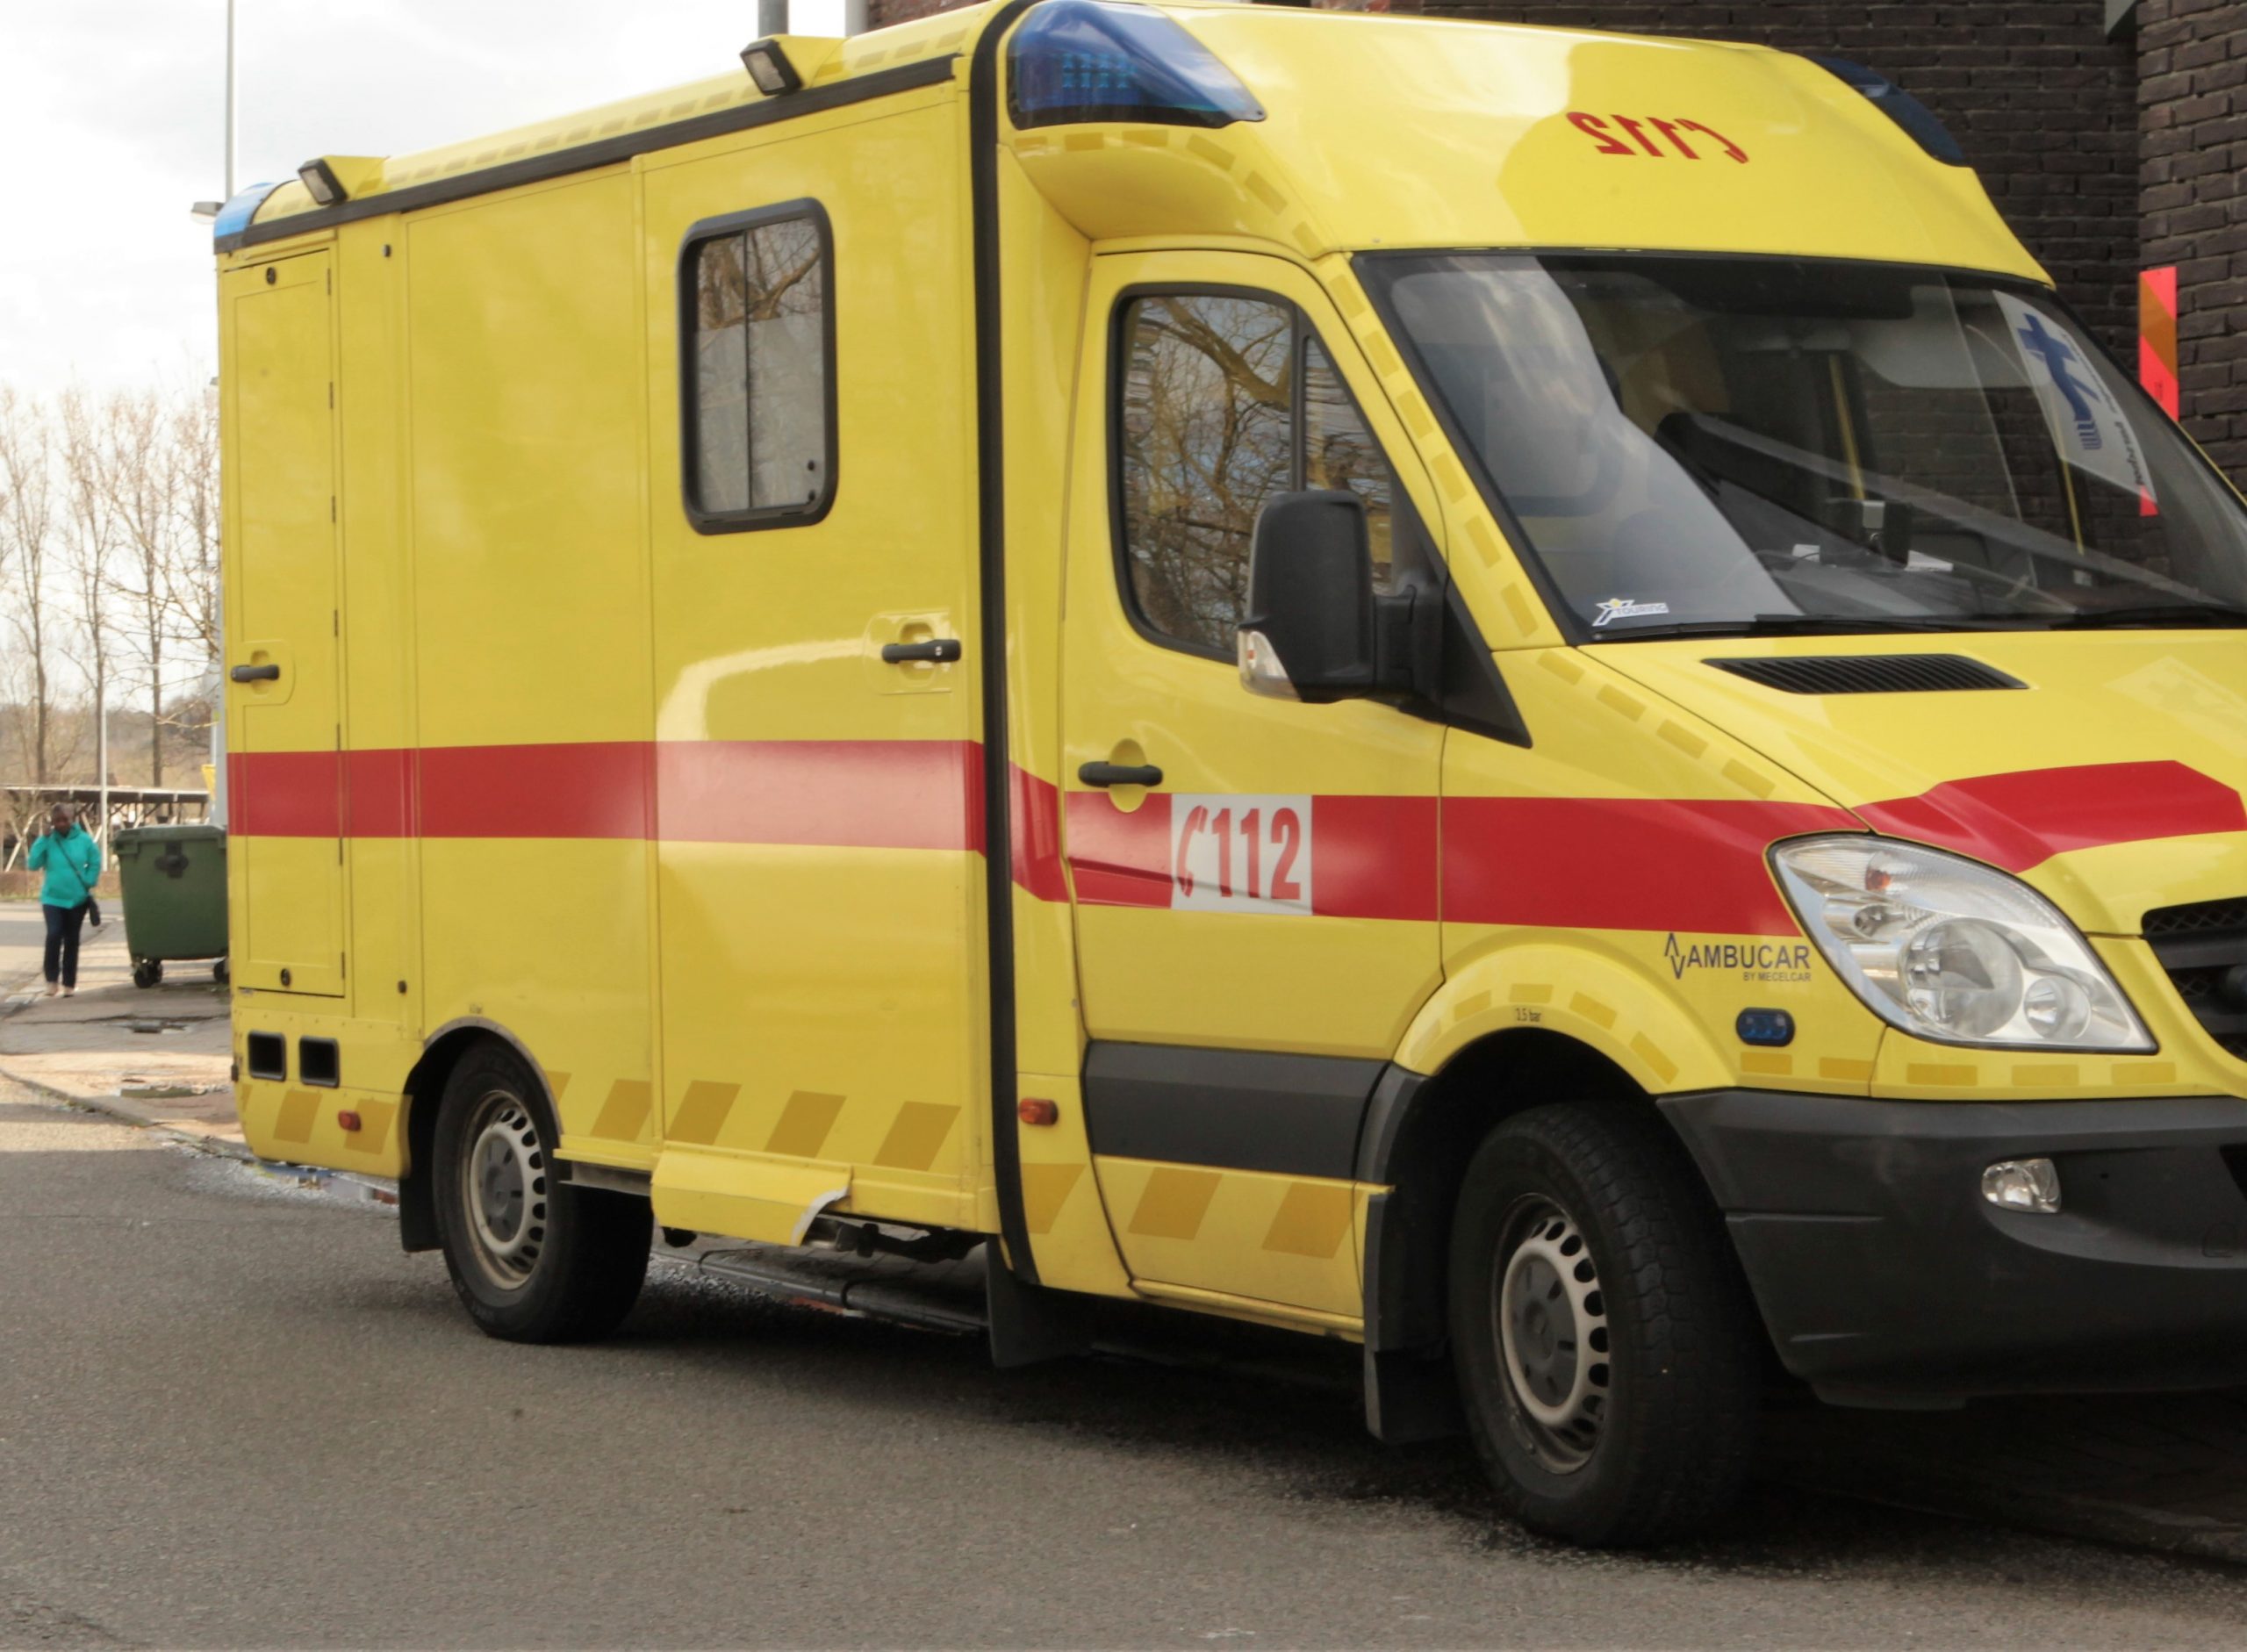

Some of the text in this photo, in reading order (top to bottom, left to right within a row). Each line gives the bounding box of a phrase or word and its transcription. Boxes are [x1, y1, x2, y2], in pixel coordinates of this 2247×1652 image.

[1211, 807, 1301, 901] 112
[1687, 945, 1811, 970] AMBUCAR
[1743, 972, 1812, 981] BY MECELCAR
